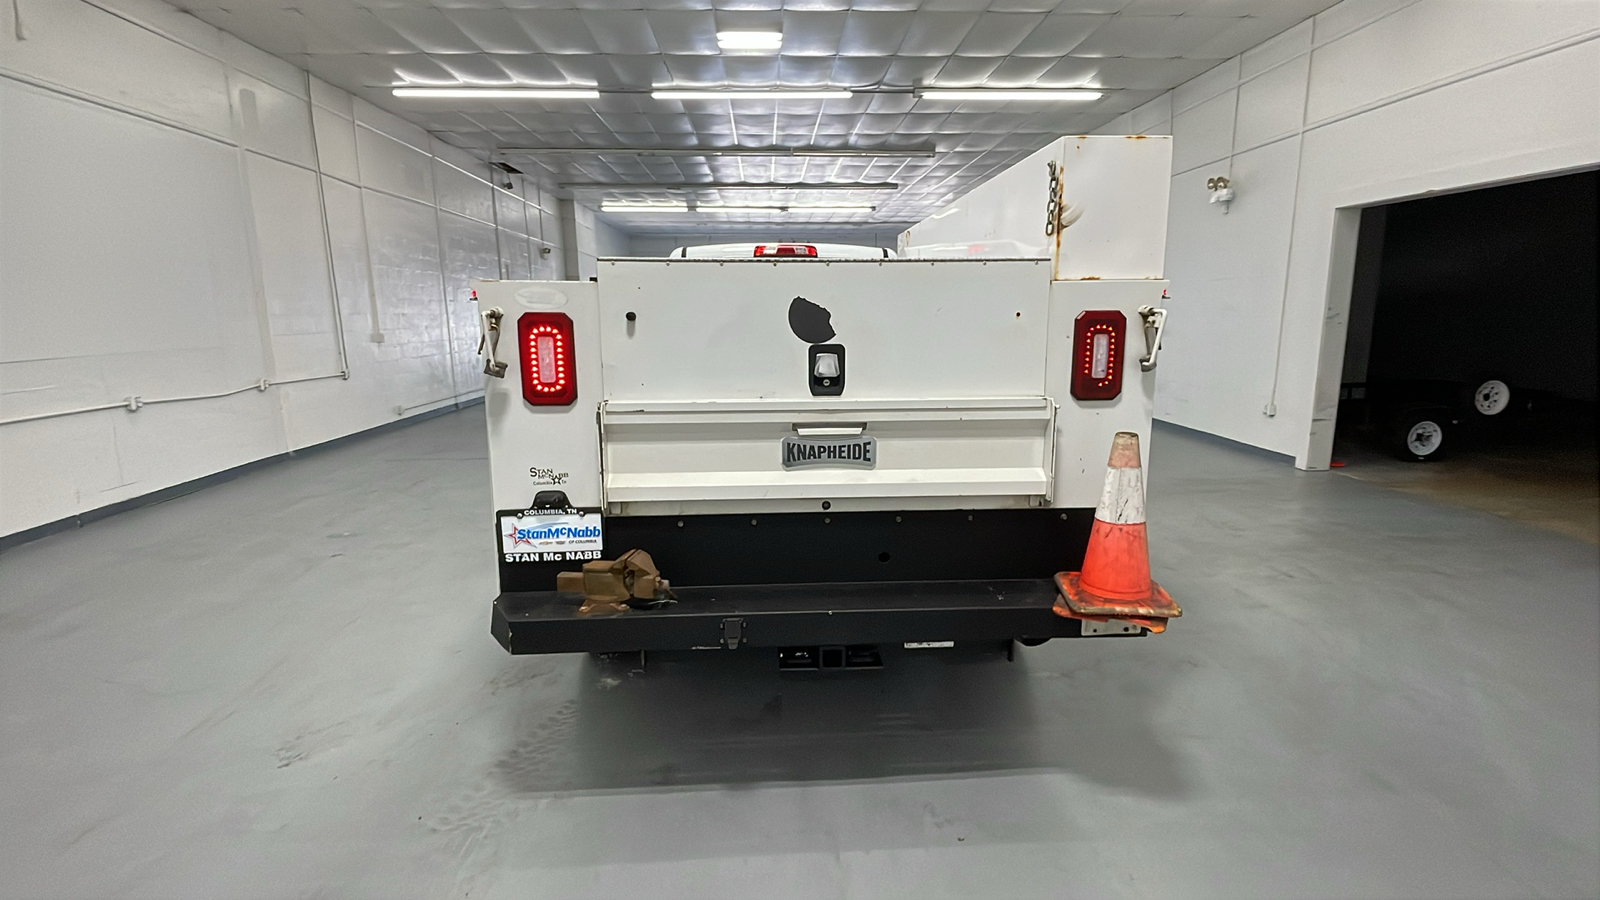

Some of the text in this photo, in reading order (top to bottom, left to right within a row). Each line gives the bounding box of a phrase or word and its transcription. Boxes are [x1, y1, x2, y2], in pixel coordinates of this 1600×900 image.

[786, 441, 872, 463] KNAPHEIDE
[529, 467, 553, 478] STAN
[524, 508, 566, 516] COLUMBIA,
[505, 550, 602, 563] STAN Mc NABB
